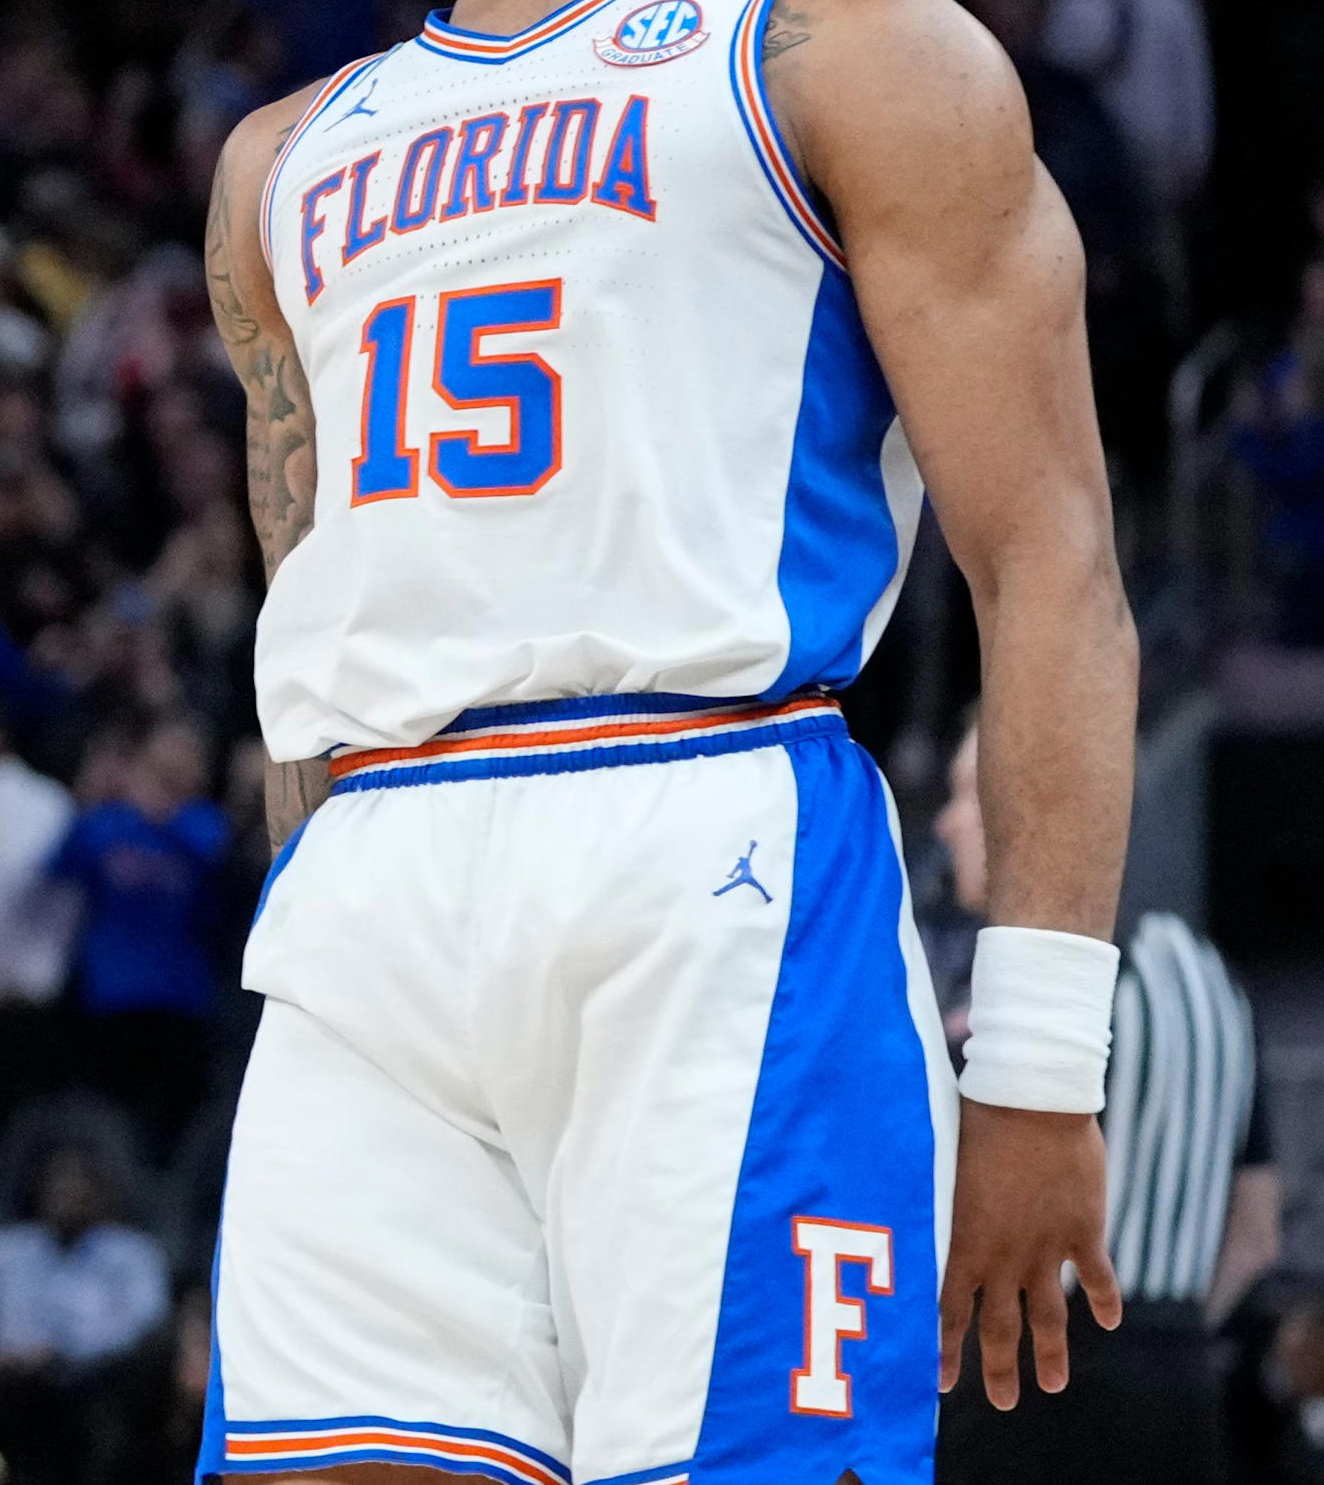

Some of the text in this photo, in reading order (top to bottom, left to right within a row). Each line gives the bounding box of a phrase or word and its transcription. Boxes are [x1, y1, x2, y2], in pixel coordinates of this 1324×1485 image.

[601, 43, 688, 64] GRADUATE
[620, 0, 699, 49] SEC
[300, 94, 656, 306] FLORIDA
[350, 277, 562, 508] 15
[789, 1214, 895, 1418] F
